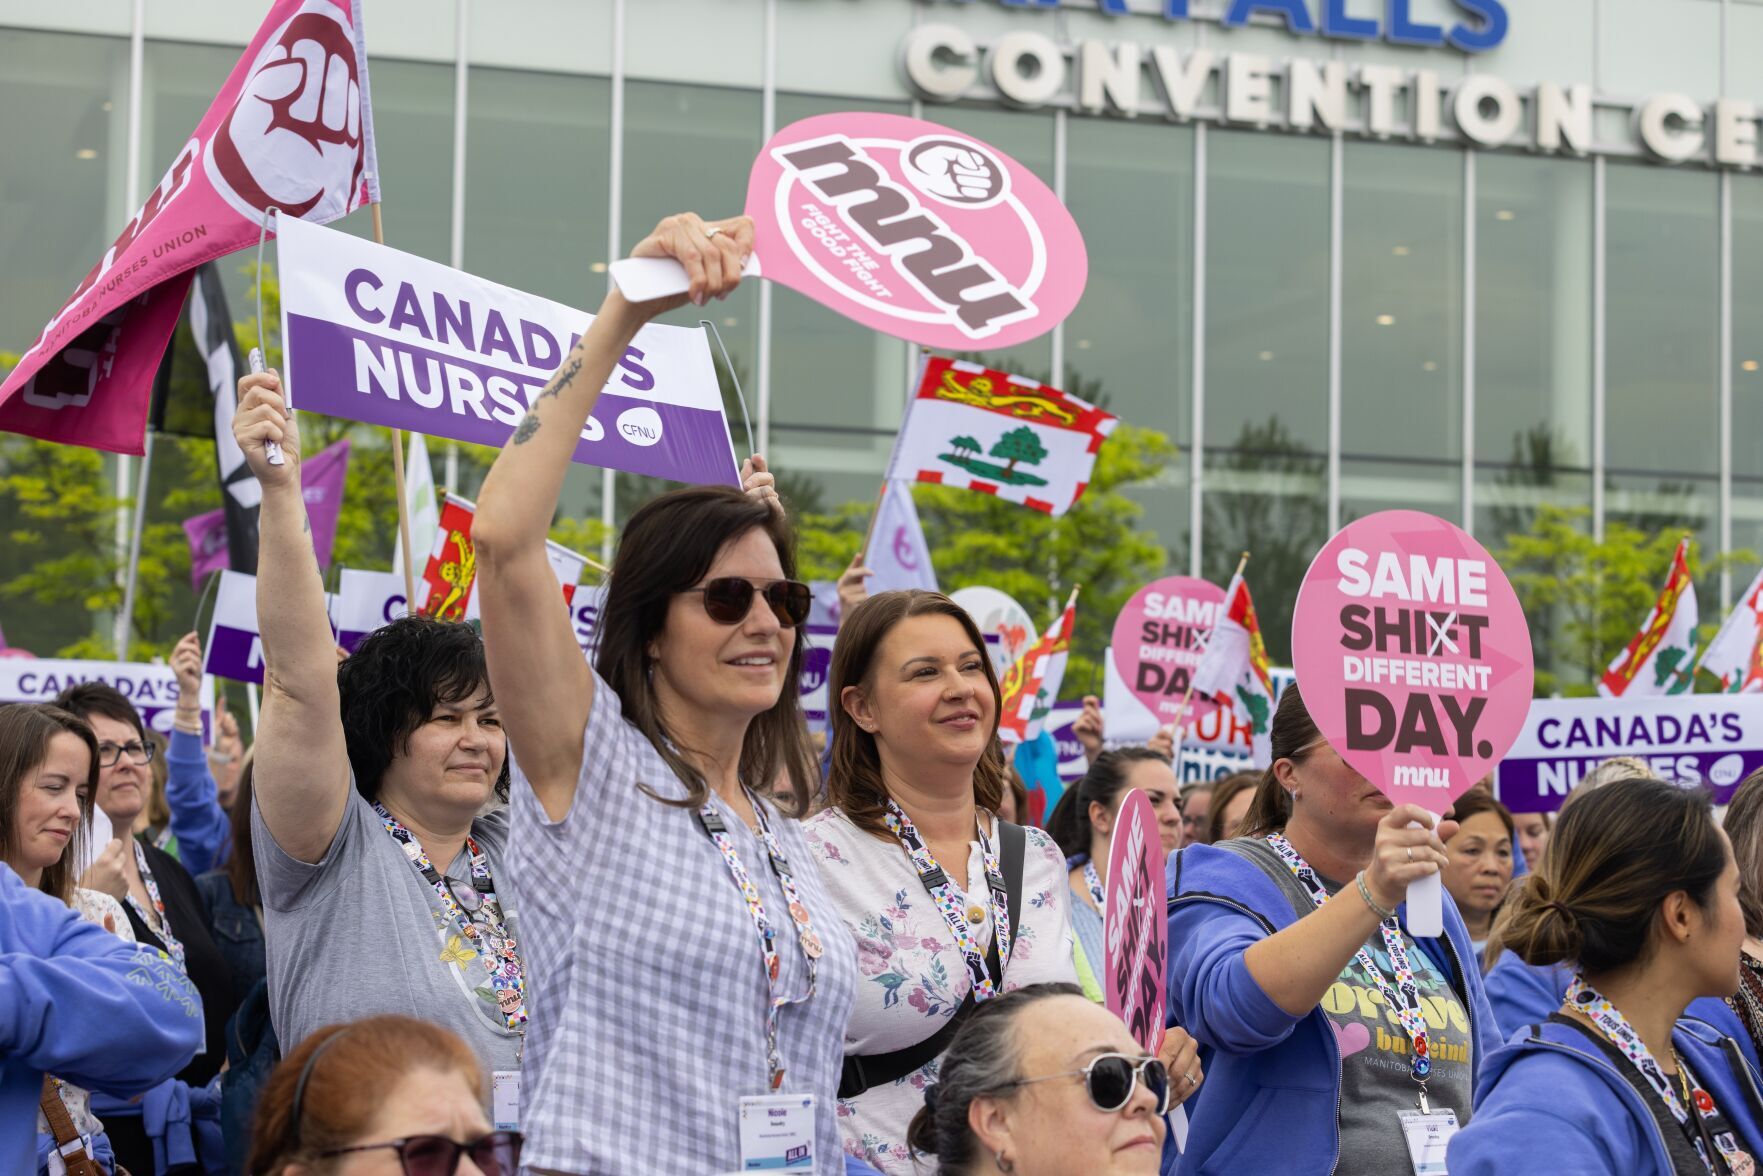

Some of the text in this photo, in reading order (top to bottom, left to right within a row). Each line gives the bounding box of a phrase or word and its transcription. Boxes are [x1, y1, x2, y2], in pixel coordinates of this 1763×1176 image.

[905, 23, 1592, 152] CONVENTION
[99, 257, 149, 299] NURSES
[152, 224, 208, 259] UNION
[780, 139, 1029, 331] mnu
[800, 218, 892, 298] GOOD FIGHT
[801, 203, 880, 271] FIGHT THE
[344, 268, 655, 391] CANADS
[622, 422, 656, 440] CFNU
[1337, 548, 1488, 608] SAME
[1340, 603, 1489, 660] SHIFT
[1343, 656, 1492, 691] DIFFERENT
[1344, 687, 1493, 759] DAY.
[1537, 713, 1744, 749] CANADA'S
[1393, 765, 1450, 788] mnu
[1108, 800, 1144, 969] SAME
[947, 912, 967, 933] ALL IN
[998, 923, 1008, 948] ALL IN
[1124, 880, 1156, 1032] DIFFERENT
[1358, 954, 1370, 964] ALL
[1599, 1014, 1619, 1030] TOUS
